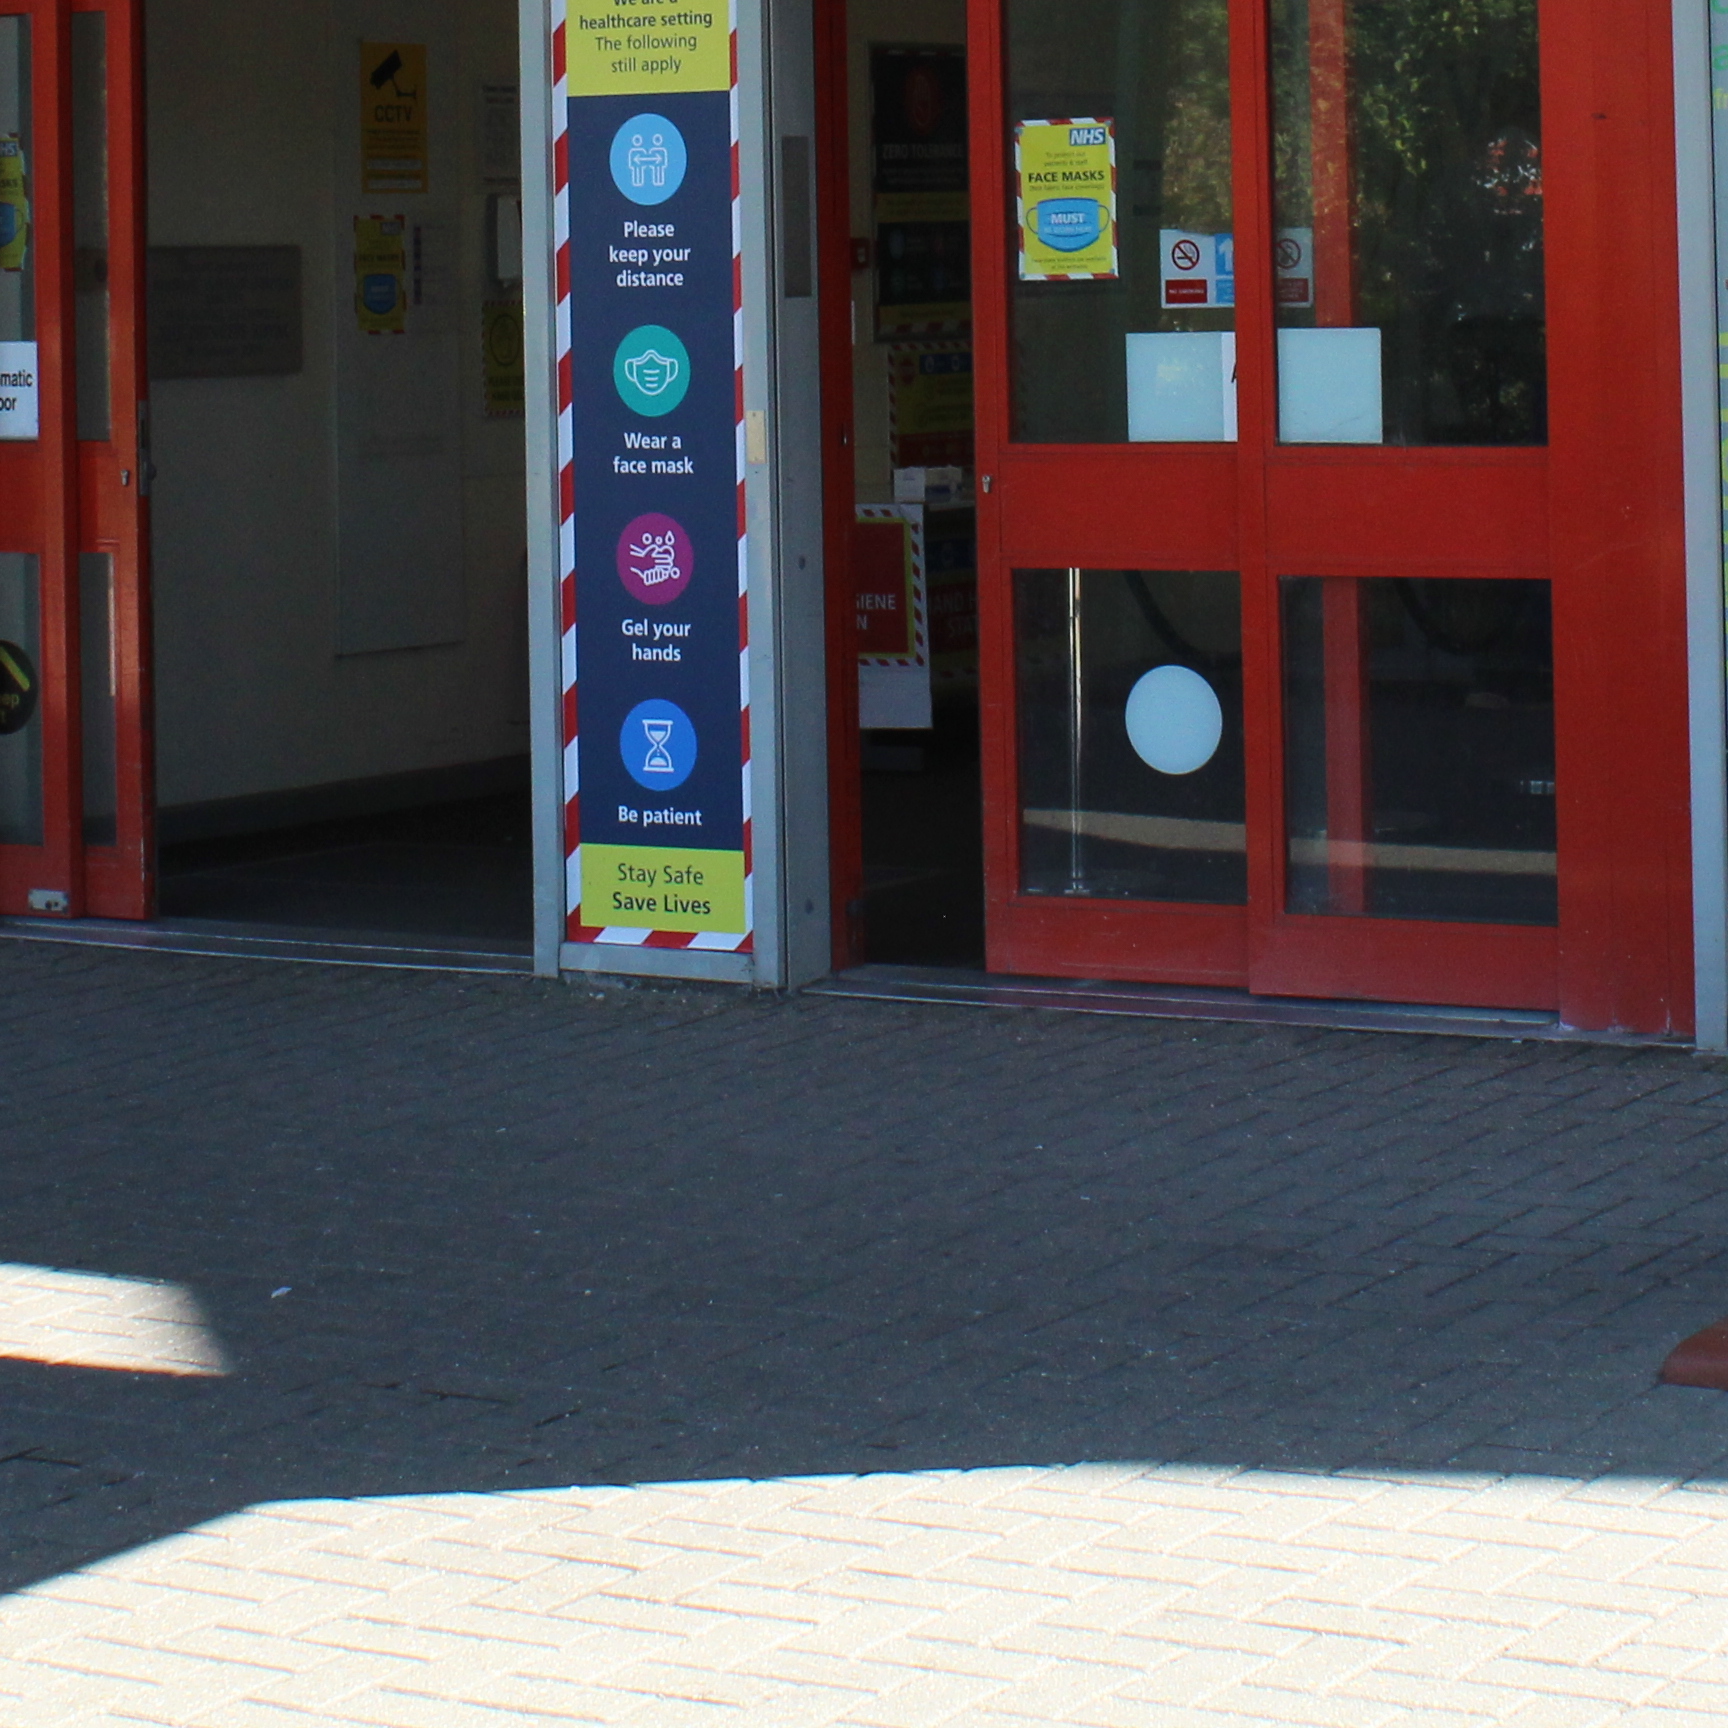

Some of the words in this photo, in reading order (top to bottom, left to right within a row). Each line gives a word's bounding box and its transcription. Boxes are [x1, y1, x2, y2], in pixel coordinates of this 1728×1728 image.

[579, 12, 657, 31] healthcare
[660, 9, 713, 31] setting
[595, 36, 622, 52] The
[626, 32, 698, 53] following
[611, 56, 638, 74] still
[641, 55, 682, 75] apply
[375, 104, 412, 123] CCTV
[1070, 128, 1105, 145] NHS
[1028, 172, 1058, 183] FACE
[1062, 170, 1105, 182] MASKS
[1050, 213, 1085, 224] MUST
[623, 220, 675, 239] Please
[609, 245, 650, 266] keep
[653, 248, 691, 265] your
[616, 269, 684, 288] distance
[623, 432, 668, 450] Wear
[672, 437, 682, 450] a
[613, 456, 648, 475] face
[652, 456, 695, 475] mask
[621, 618, 648, 638] Gel
[652, 621, 692, 641] your
[631, 642, 682, 663] hands
[617, 805, 639, 824] Be
[642, 807, 703, 828] patient
[617, 863, 658, 886] Stay
[662, 865, 704, 886] Safe
[612, 892, 657, 913] Save
[662, 893, 712, 915] Lives
